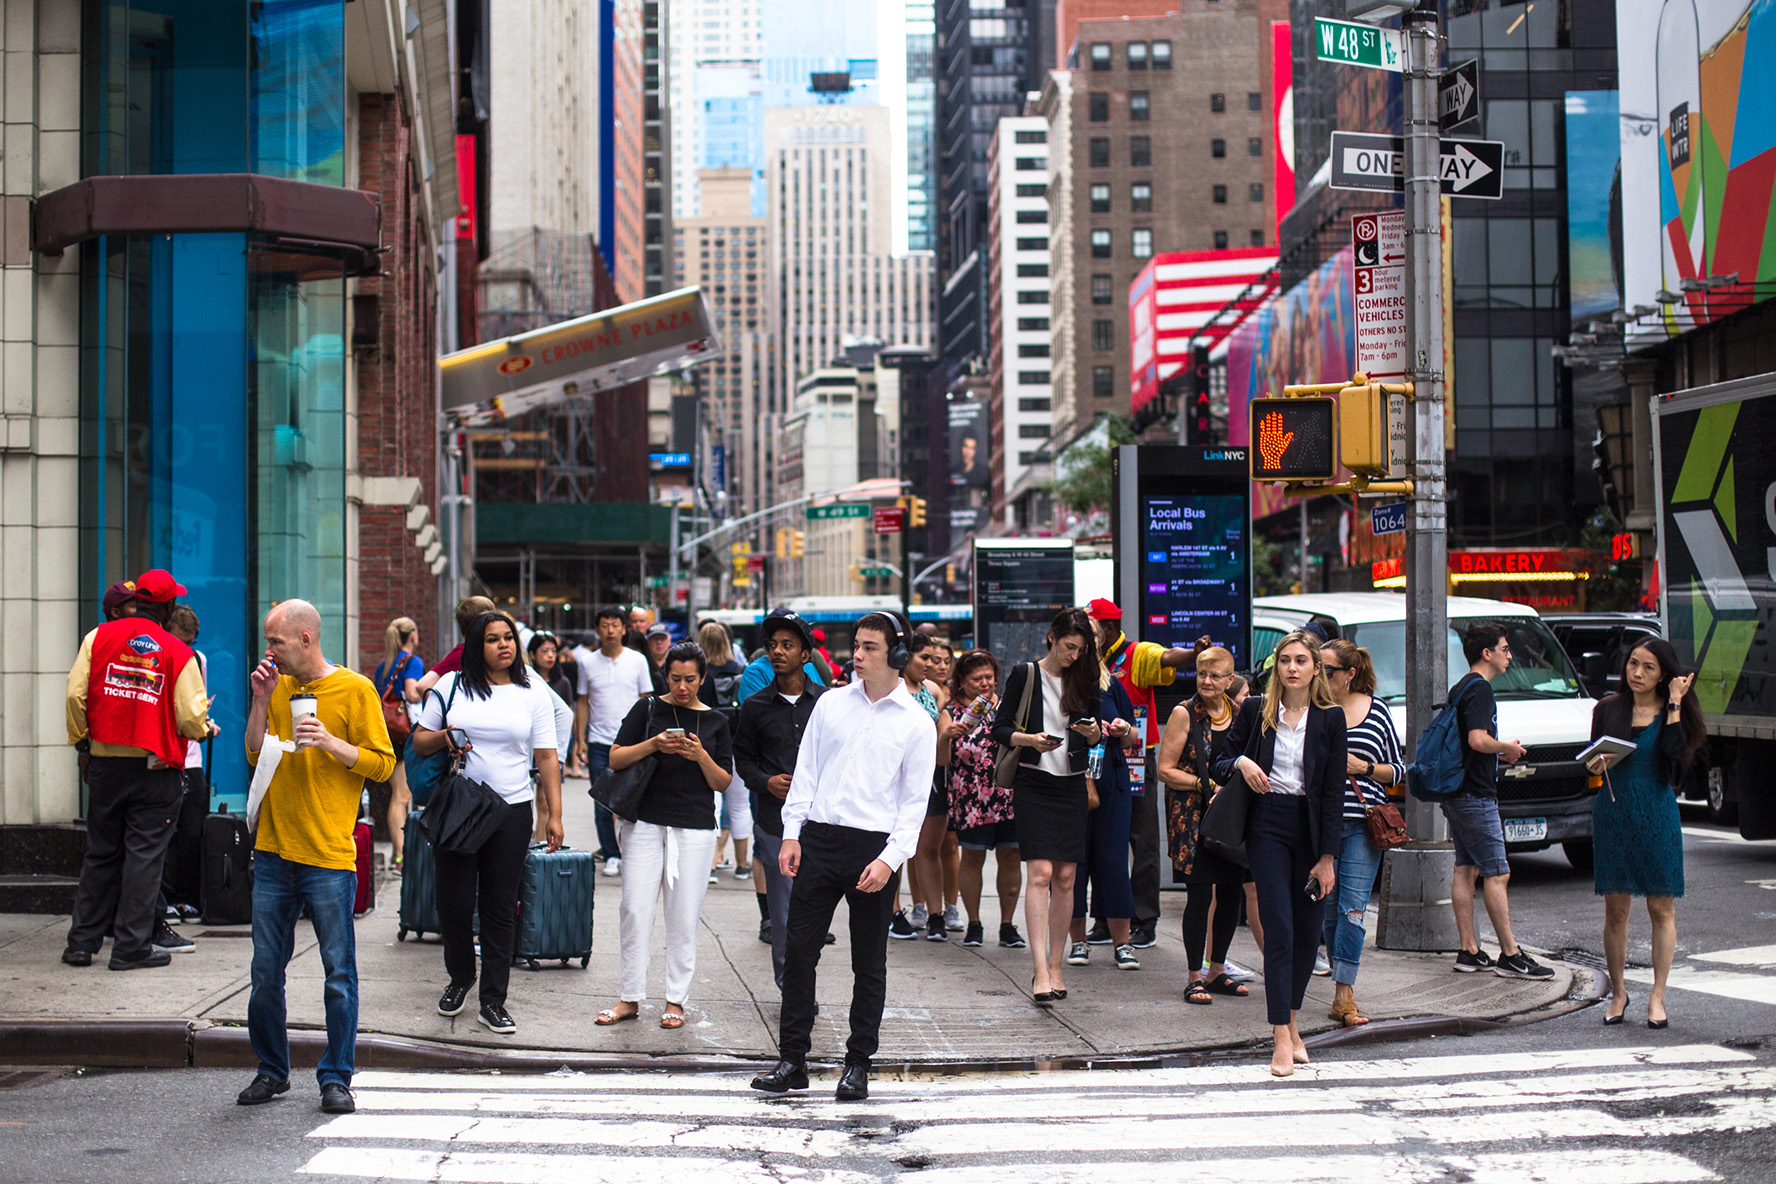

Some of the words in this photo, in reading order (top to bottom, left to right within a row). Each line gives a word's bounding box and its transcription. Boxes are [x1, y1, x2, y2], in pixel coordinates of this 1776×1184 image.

[1321, 24, 1334, 56] W
[1339, 27, 1359, 60] 48
[1362, 30, 1375, 48] ST
[1446, 82, 1467, 112] WAY
[1671, 114, 1688, 137] LIFE
[1671, 137, 1688, 160] WTR
[1356, 151, 1404, 175] ONE
[1440, 157, 1477, 179] AY
[1381, 215, 1405, 223] Monday
[1381, 224, 1405, 232] Wednes
[1381, 233, 1400, 241] Friday
[1382, 242, 1395, 250] 3am
[1358, 270, 1371, 293] 3
[1374, 275, 1401, 284] metered
[1374, 283, 1398, 292] parking
[1358, 296, 1406, 310] COMMERC
[1359, 309, 1404, 322] VEHICLES
[1359, 327, 1386, 337] OTHERS
[1387, 326, 1397, 334] NO
[1398, 325, 1407, 334] ST
[541, 330, 624, 365] CROWNE
[631, 310, 693, 340] PLAZA
[1360, 340, 1388, 351] Monday
[1394, 339, 1406, 348] Fri
[1360, 353, 1375, 361] 7am
[1381, 352, 1398, 362] 6pm
[1196, 363, 1210, 446] CAR
[1389, 399, 1405, 407] ered
[1396, 421, 1406, 431] Fri
[1203, 450, 1245, 461] LinkNYC
[1149, 507, 1181, 518] Local
[1183, 507, 1206, 518] Bus
[1149, 519, 1193, 530] Arrivals
[1374, 514, 1406, 532] 1064
[1230, 551, 1235, 560] 1
[1461, 553, 1545, 573] BAKERY
[1230, 583, 1235, 592] 1
[1501, 595, 1575, 608] RESTAURANT
[1230, 614, 1236, 623] 1
[1231, 645, 1236, 654] 1
[103, 686, 137, 700] TICKET
